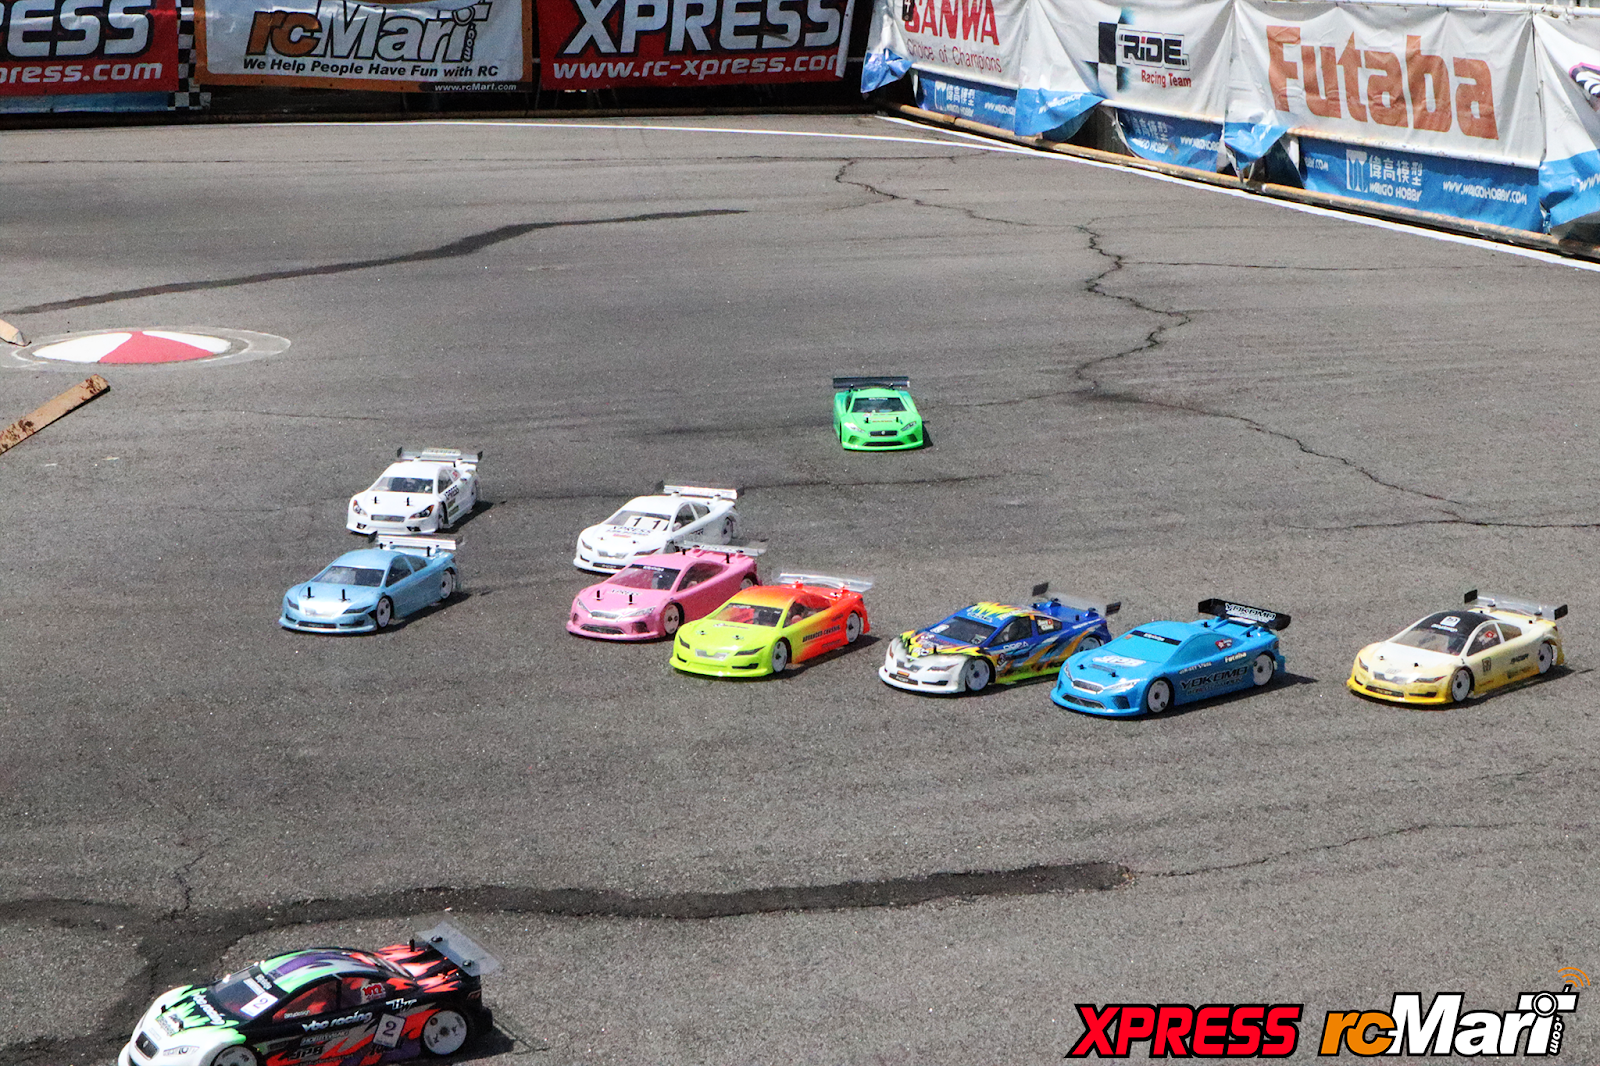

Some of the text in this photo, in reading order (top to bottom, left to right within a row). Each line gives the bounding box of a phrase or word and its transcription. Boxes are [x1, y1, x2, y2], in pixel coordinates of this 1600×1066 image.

[0, 0, 150, 57] ESS
[563, 0, 840, 54] XPRESS
[243, 58, 499, 78] We Help People Have Fun with RC
[434, 82, 517, 92] www.rcMart.com
[1141, 69, 1192, 88] Racing Team
[1266, 25, 1499, 140] Futaba
[1395, 186, 1423, 203] HOBBY
[382, 1020, 397, 1037] 2
